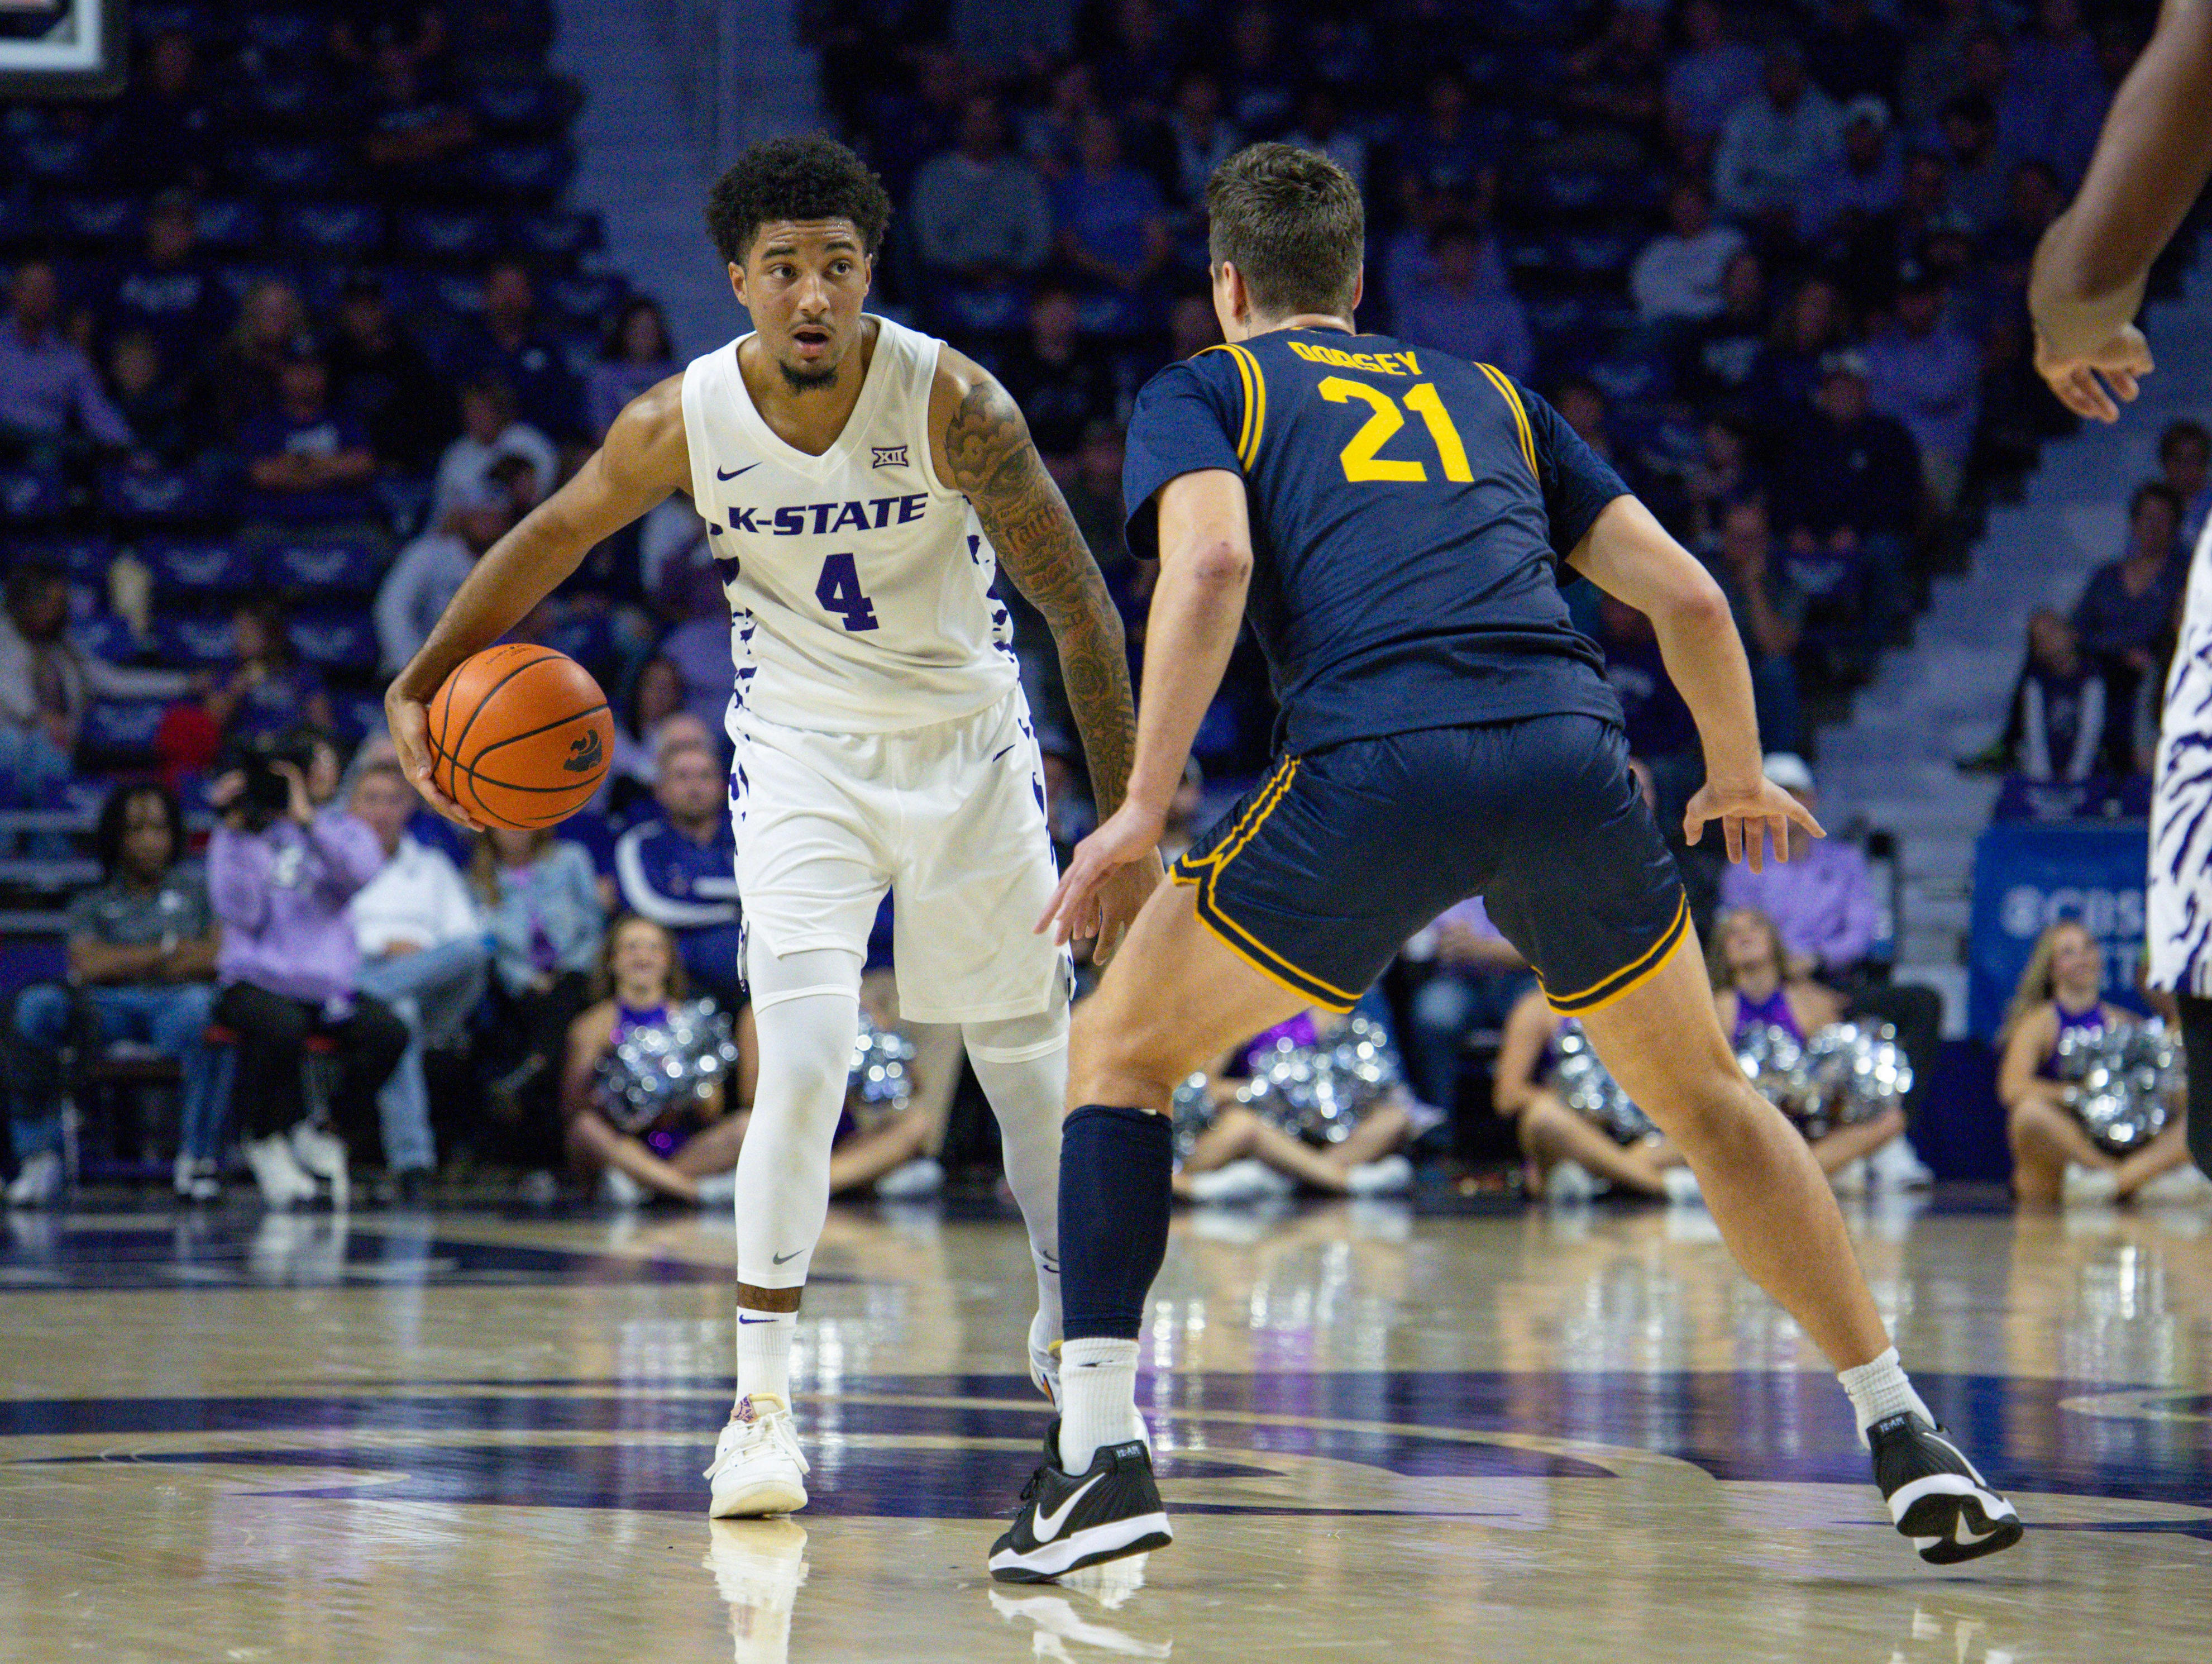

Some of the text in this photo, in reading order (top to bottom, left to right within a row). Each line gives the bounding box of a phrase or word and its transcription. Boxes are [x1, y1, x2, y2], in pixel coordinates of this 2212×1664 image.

[1287, 341, 1422, 375] DORSEY
[1317, 376, 1474, 482] 21
[872, 445, 909, 469] XII
[728, 492, 929, 535] K-STATE
[815, 552, 879, 632] 4
